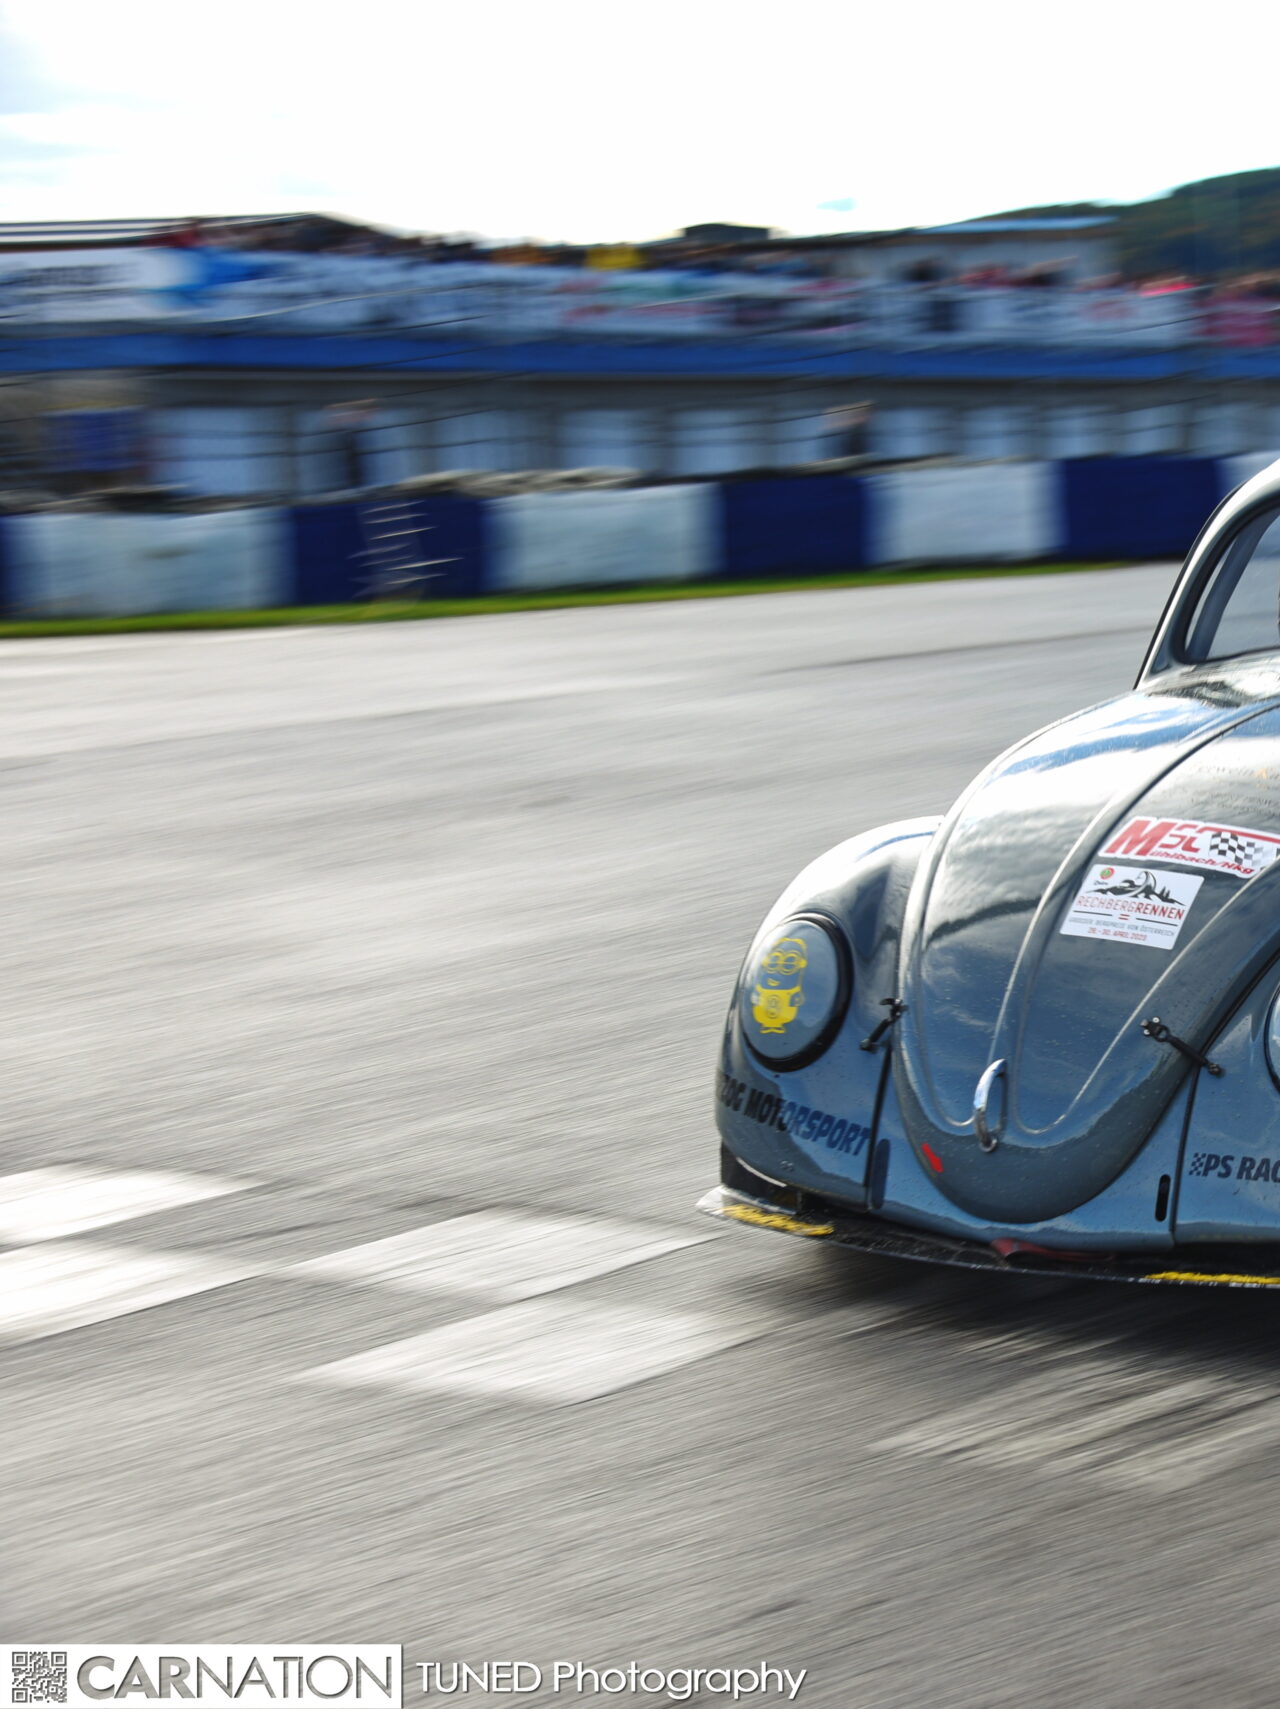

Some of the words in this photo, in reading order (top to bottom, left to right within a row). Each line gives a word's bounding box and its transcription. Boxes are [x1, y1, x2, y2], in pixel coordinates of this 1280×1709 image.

[1075, 895, 1186, 921] RECHBERGRENNEN
[743, 1086, 872, 1157] MOTORSPORT
[1202, 1152, 1235, 1179] PS
